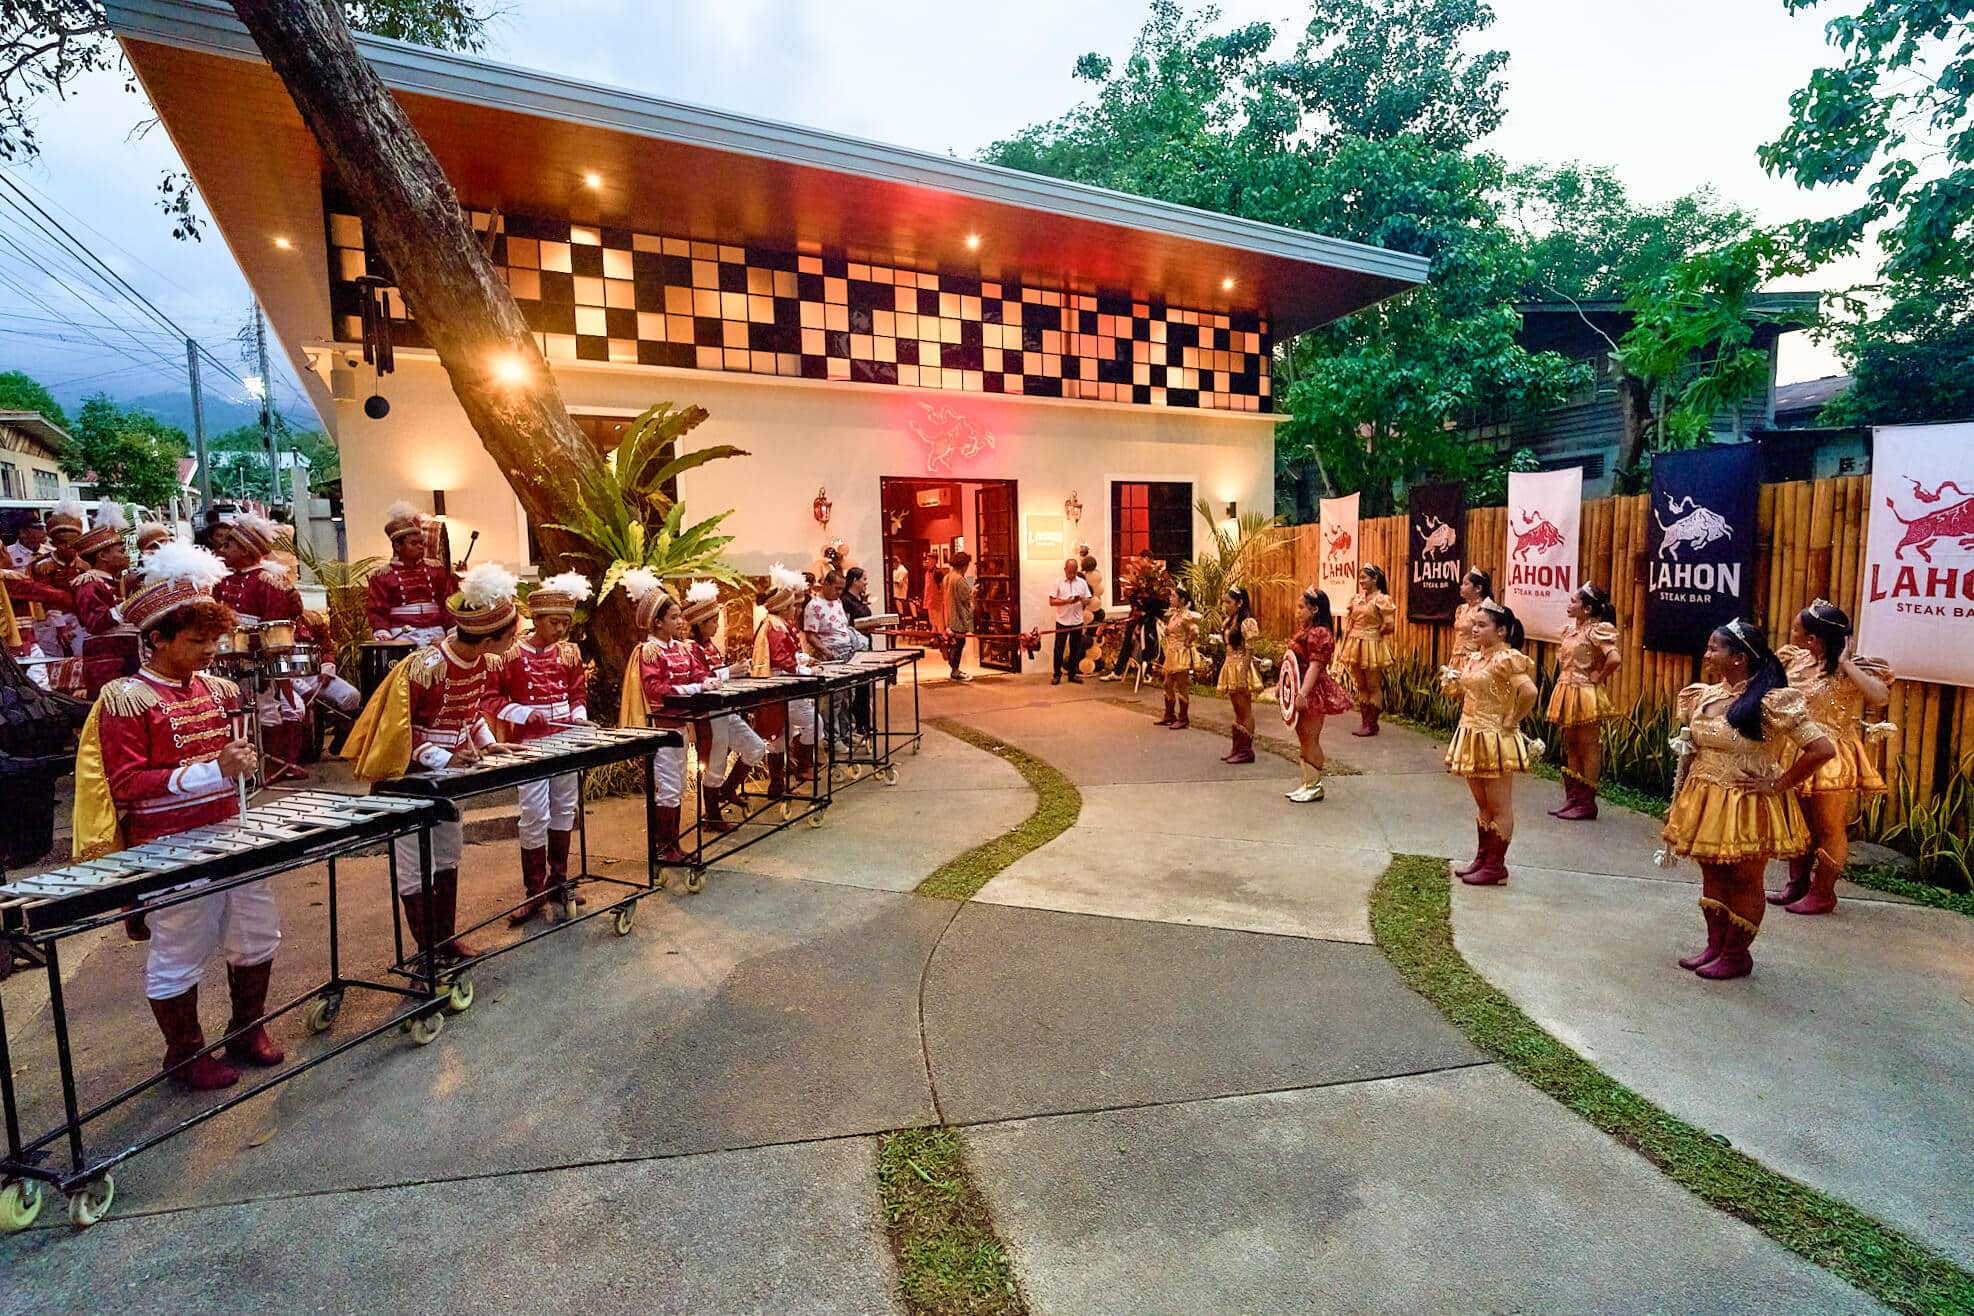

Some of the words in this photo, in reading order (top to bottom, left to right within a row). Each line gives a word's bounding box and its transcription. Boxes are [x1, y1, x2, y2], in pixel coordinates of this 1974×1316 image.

[1413, 560, 1460, 583] LAHON
[1649, 561, 1741, 597] LAHON
[1660, 592, 1686, 602] STEAK
[1689, 594, 1711, 603] BAR
[1897, 602, 1946, 616] STEAK
